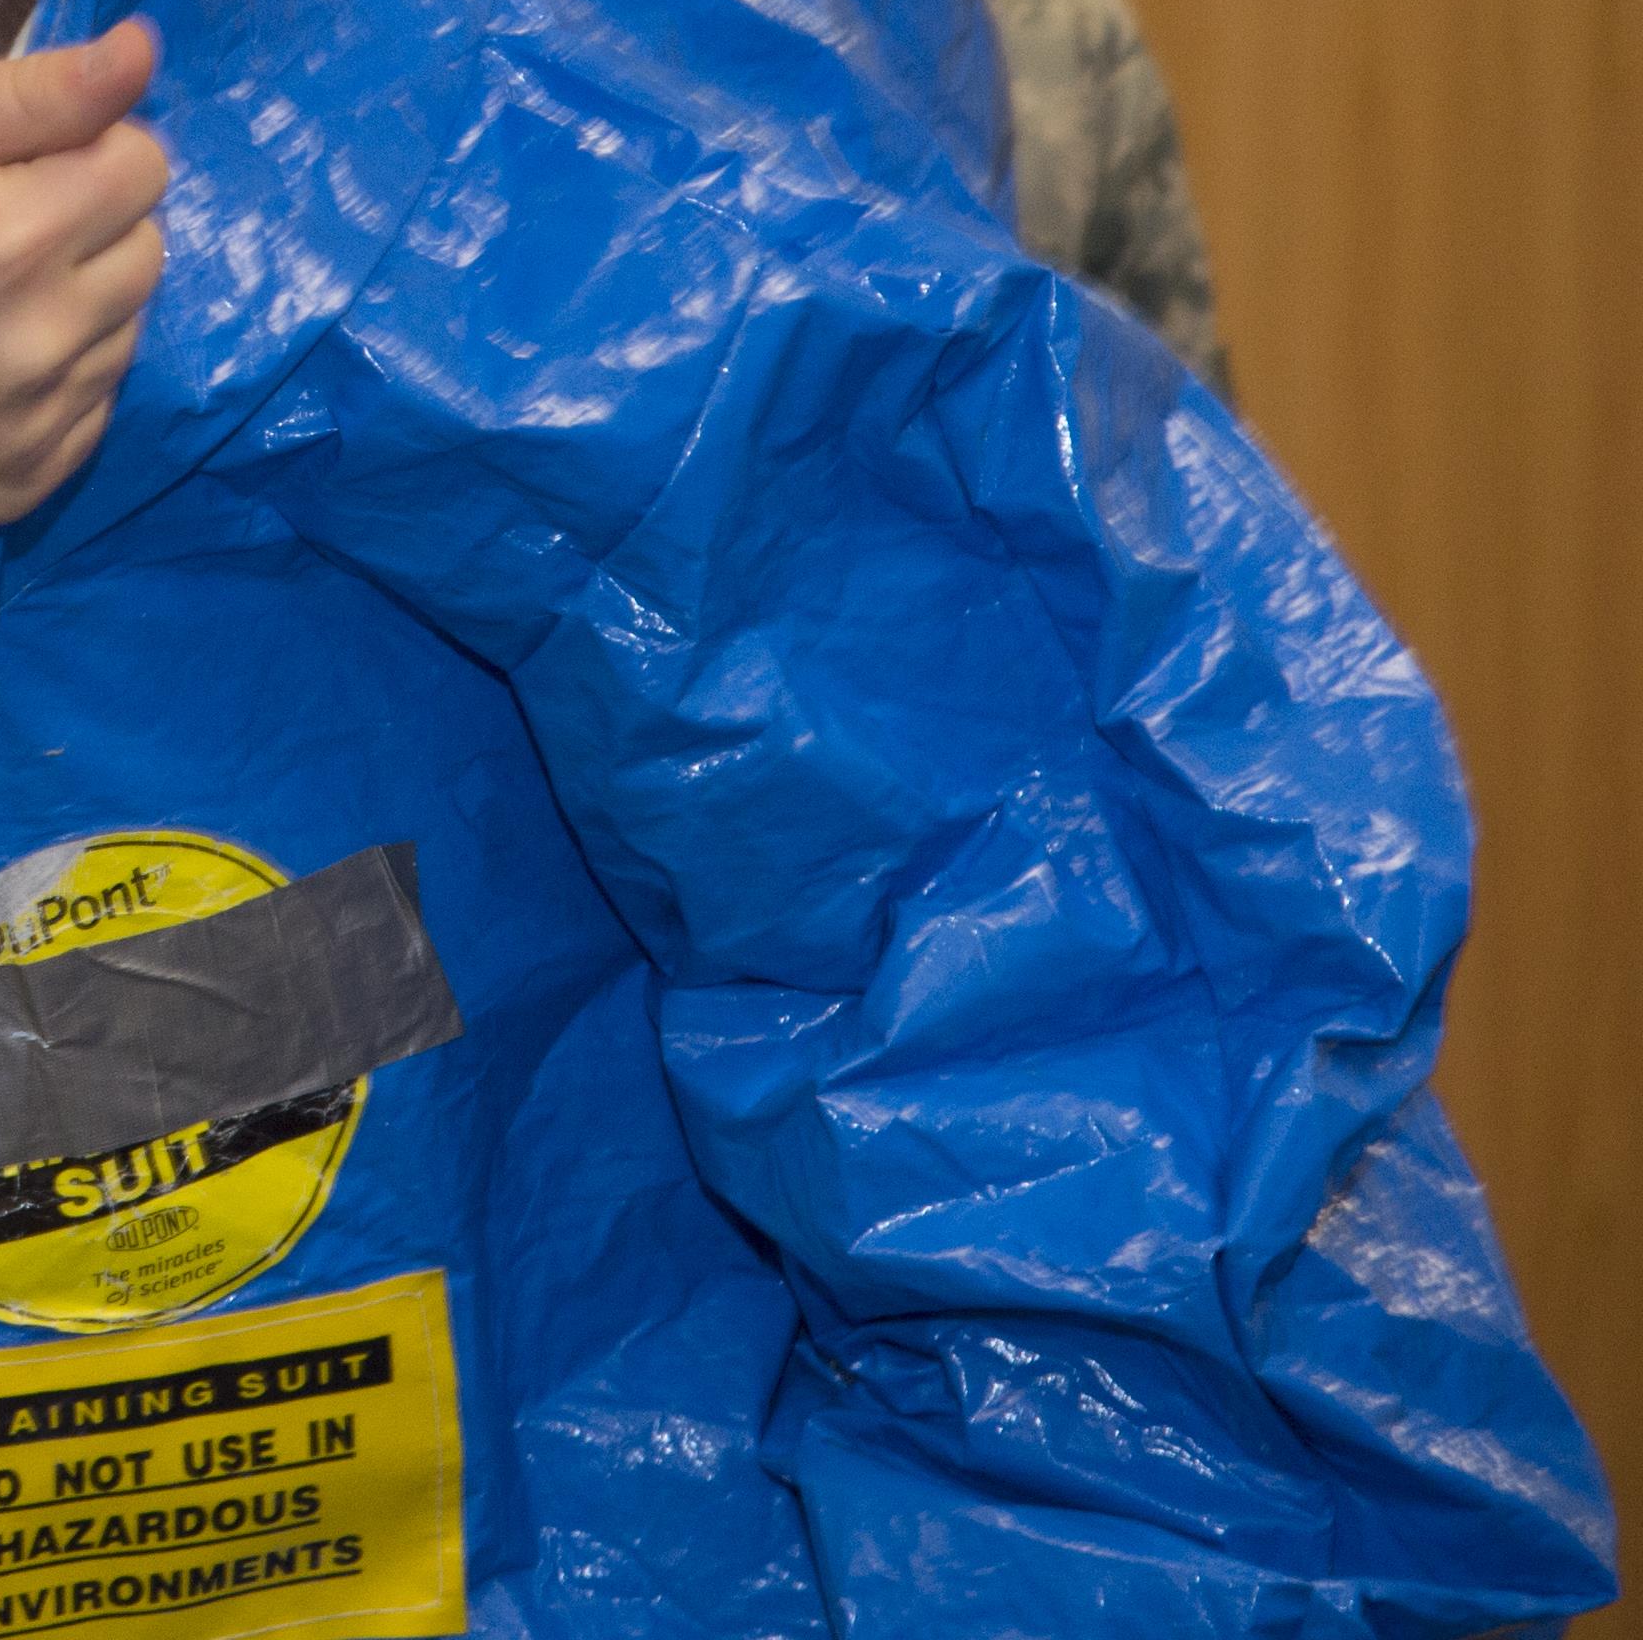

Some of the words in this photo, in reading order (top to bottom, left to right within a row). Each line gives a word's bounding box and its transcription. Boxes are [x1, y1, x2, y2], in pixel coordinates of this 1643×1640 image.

[54, 1119, 213, 1218] SUIT
[92, 1268, 131, 1290] The
[138, 1238, 227, 1279] miracles
[106, 1282, 135, 1307] of
[236, 1351, 372, 1400] SUIT
[54, 1448, 153, 1499] NOT
[182, 1427, 278, 1480] USE
[307, 1412, 357, 1459] IN
